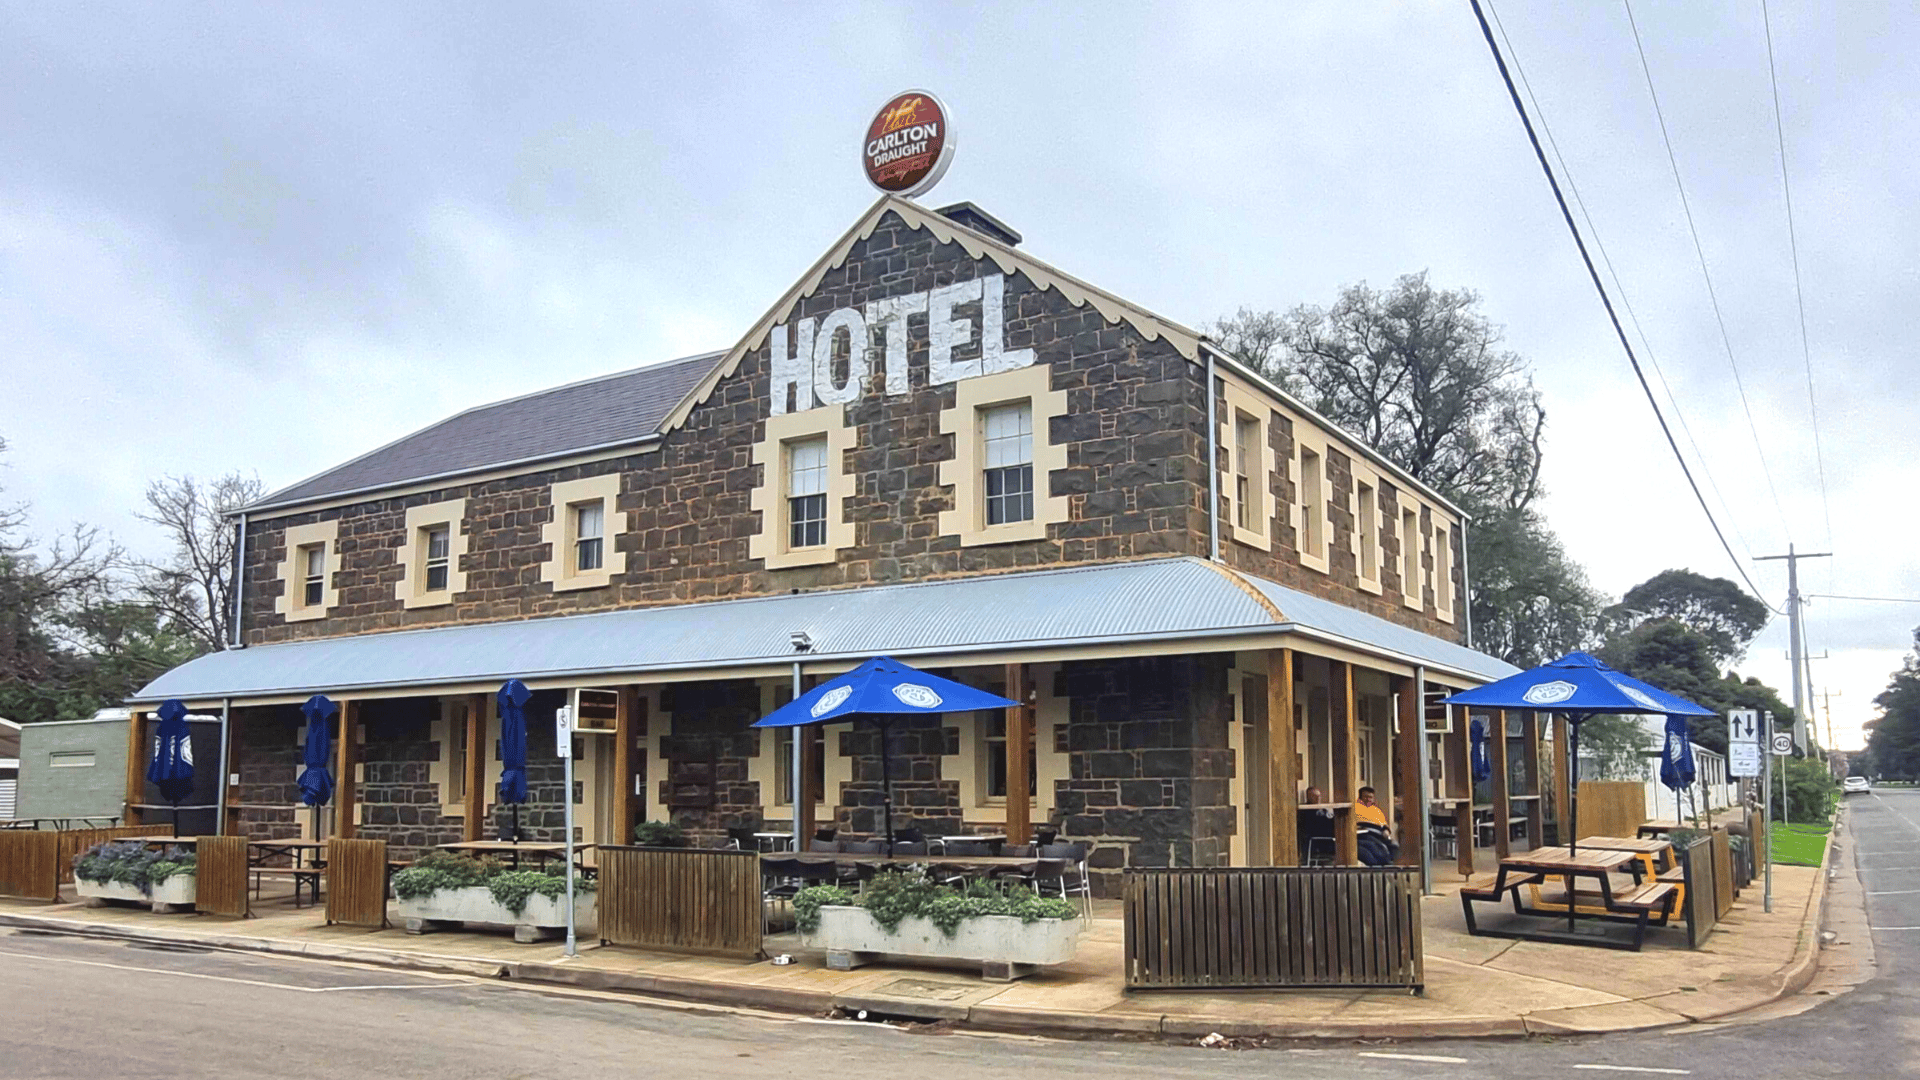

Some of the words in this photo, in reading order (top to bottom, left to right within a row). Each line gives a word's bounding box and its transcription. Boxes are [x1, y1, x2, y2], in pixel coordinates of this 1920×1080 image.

[867, 123, 938, 157] CARLTON
[874, 140, 928, 168] DRAUGHT
[769, 273, 1038, 417] HOTEL
